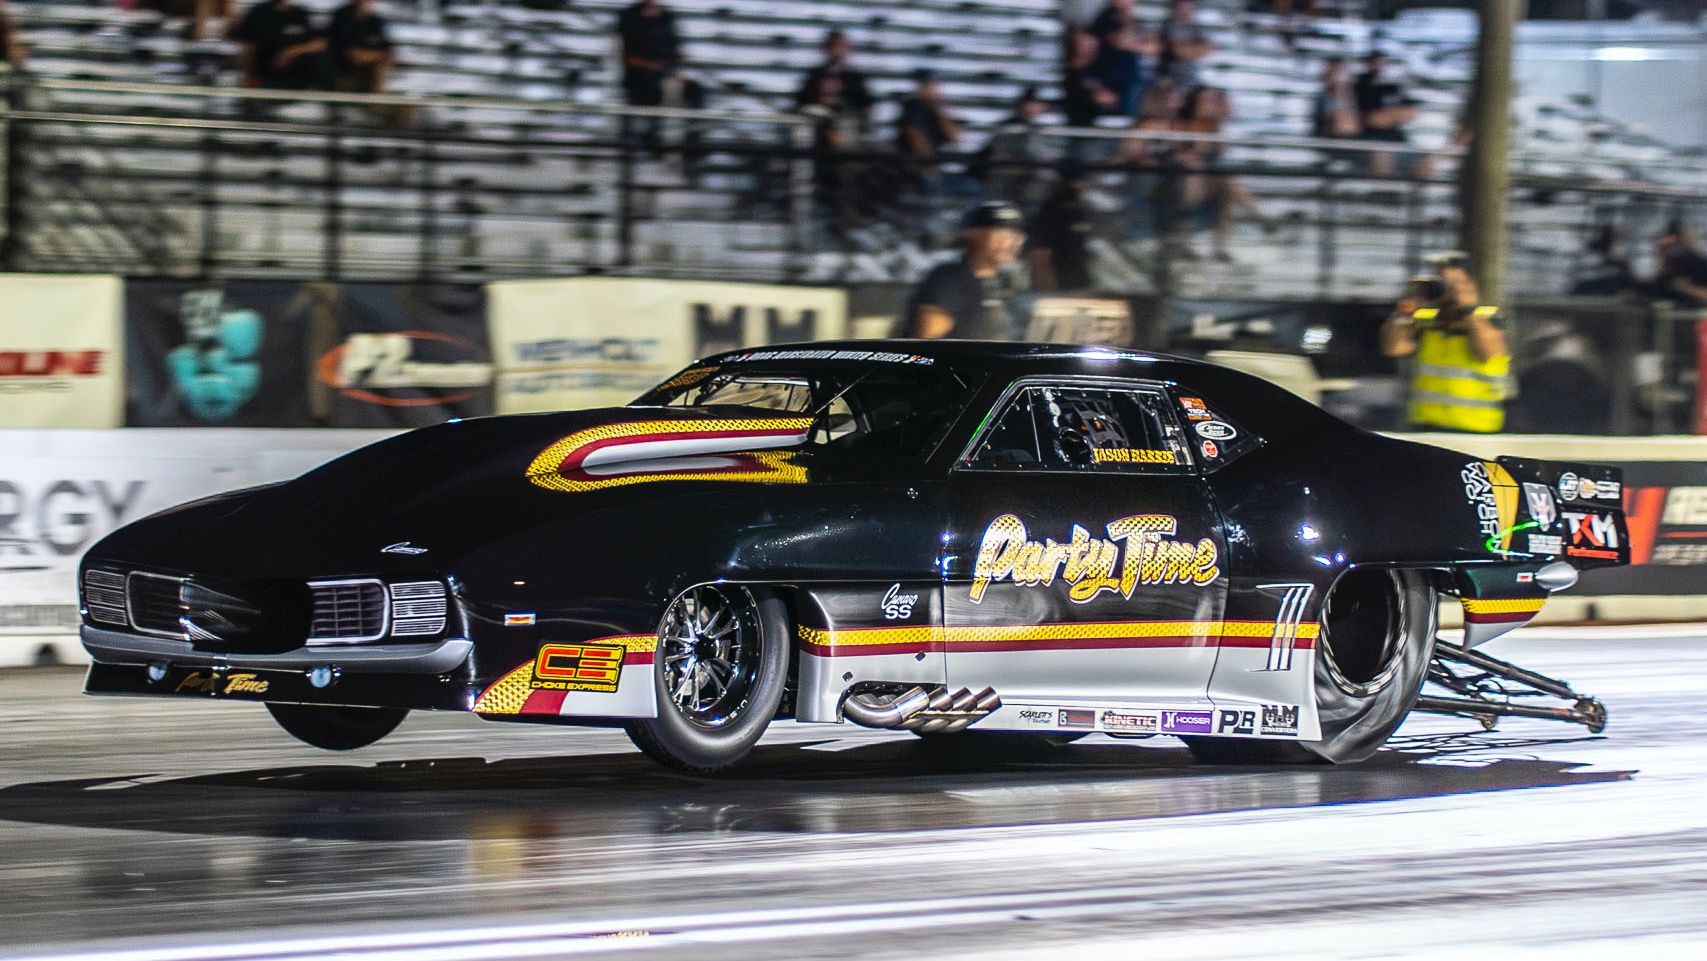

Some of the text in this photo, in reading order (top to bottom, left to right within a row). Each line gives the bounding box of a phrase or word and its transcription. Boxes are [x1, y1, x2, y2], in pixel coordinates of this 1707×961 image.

[1093, 448, 1175, 464] JASON HARRIS
[969, 513, 1220, 604] Party Time
[885, 604, 912, 619] SS
[223, 673, 269, 695] Time
[531, 681, 617, 692] CHOKE EXPRESS
[1101, 714, 1157, 727] KINETIC
[1176, 716, 1211, 725] HOOSIER
